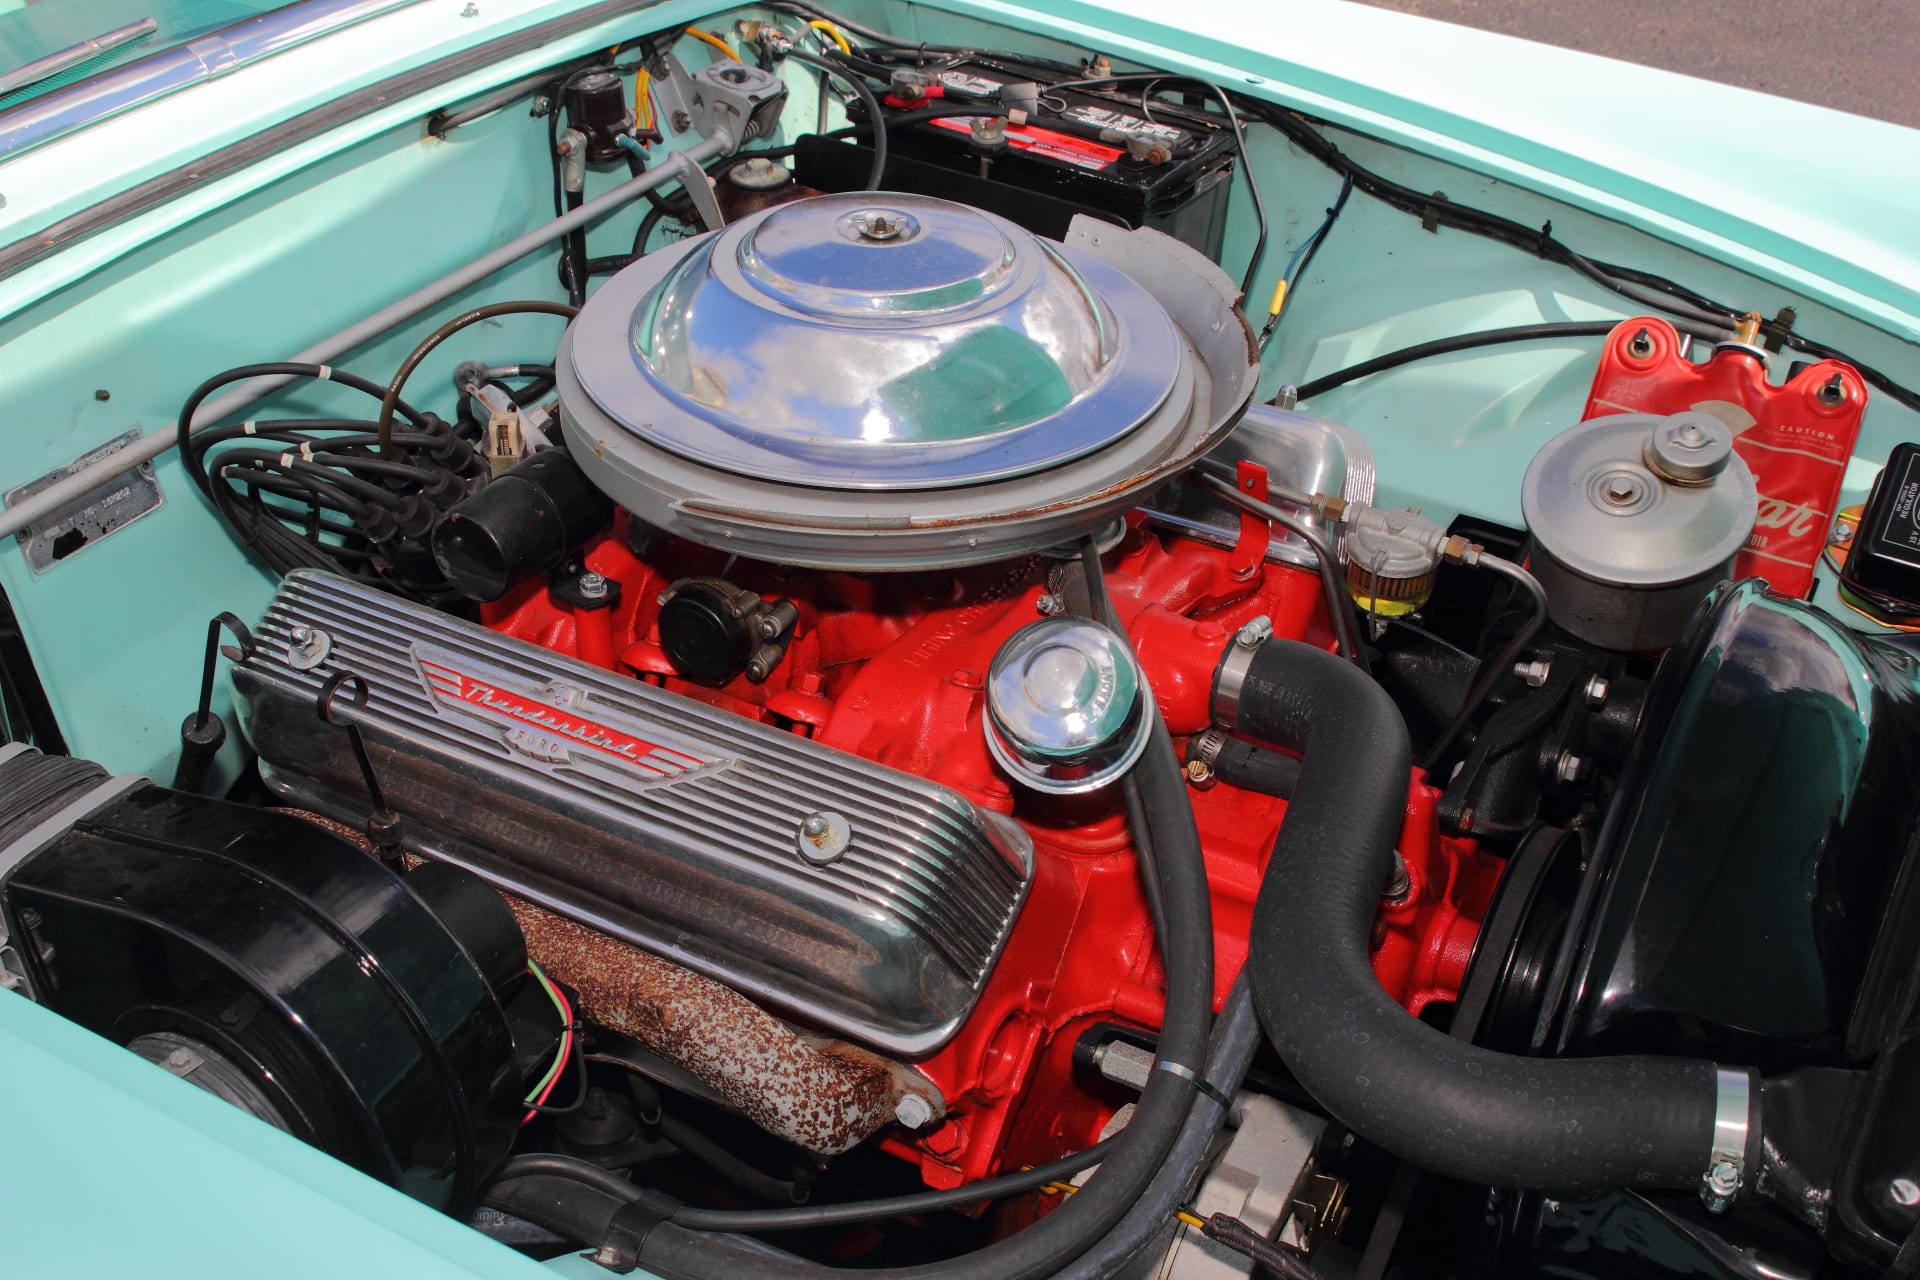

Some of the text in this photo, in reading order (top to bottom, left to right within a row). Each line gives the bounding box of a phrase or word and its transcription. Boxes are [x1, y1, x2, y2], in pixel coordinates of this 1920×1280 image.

[1779, 425, 1835, 441] CAUTION
[1900, 482, 1919, 519] REGULATOR
[464, 683, 638, 759] Thunderbird
[515, 730, 558, 752] FORD
